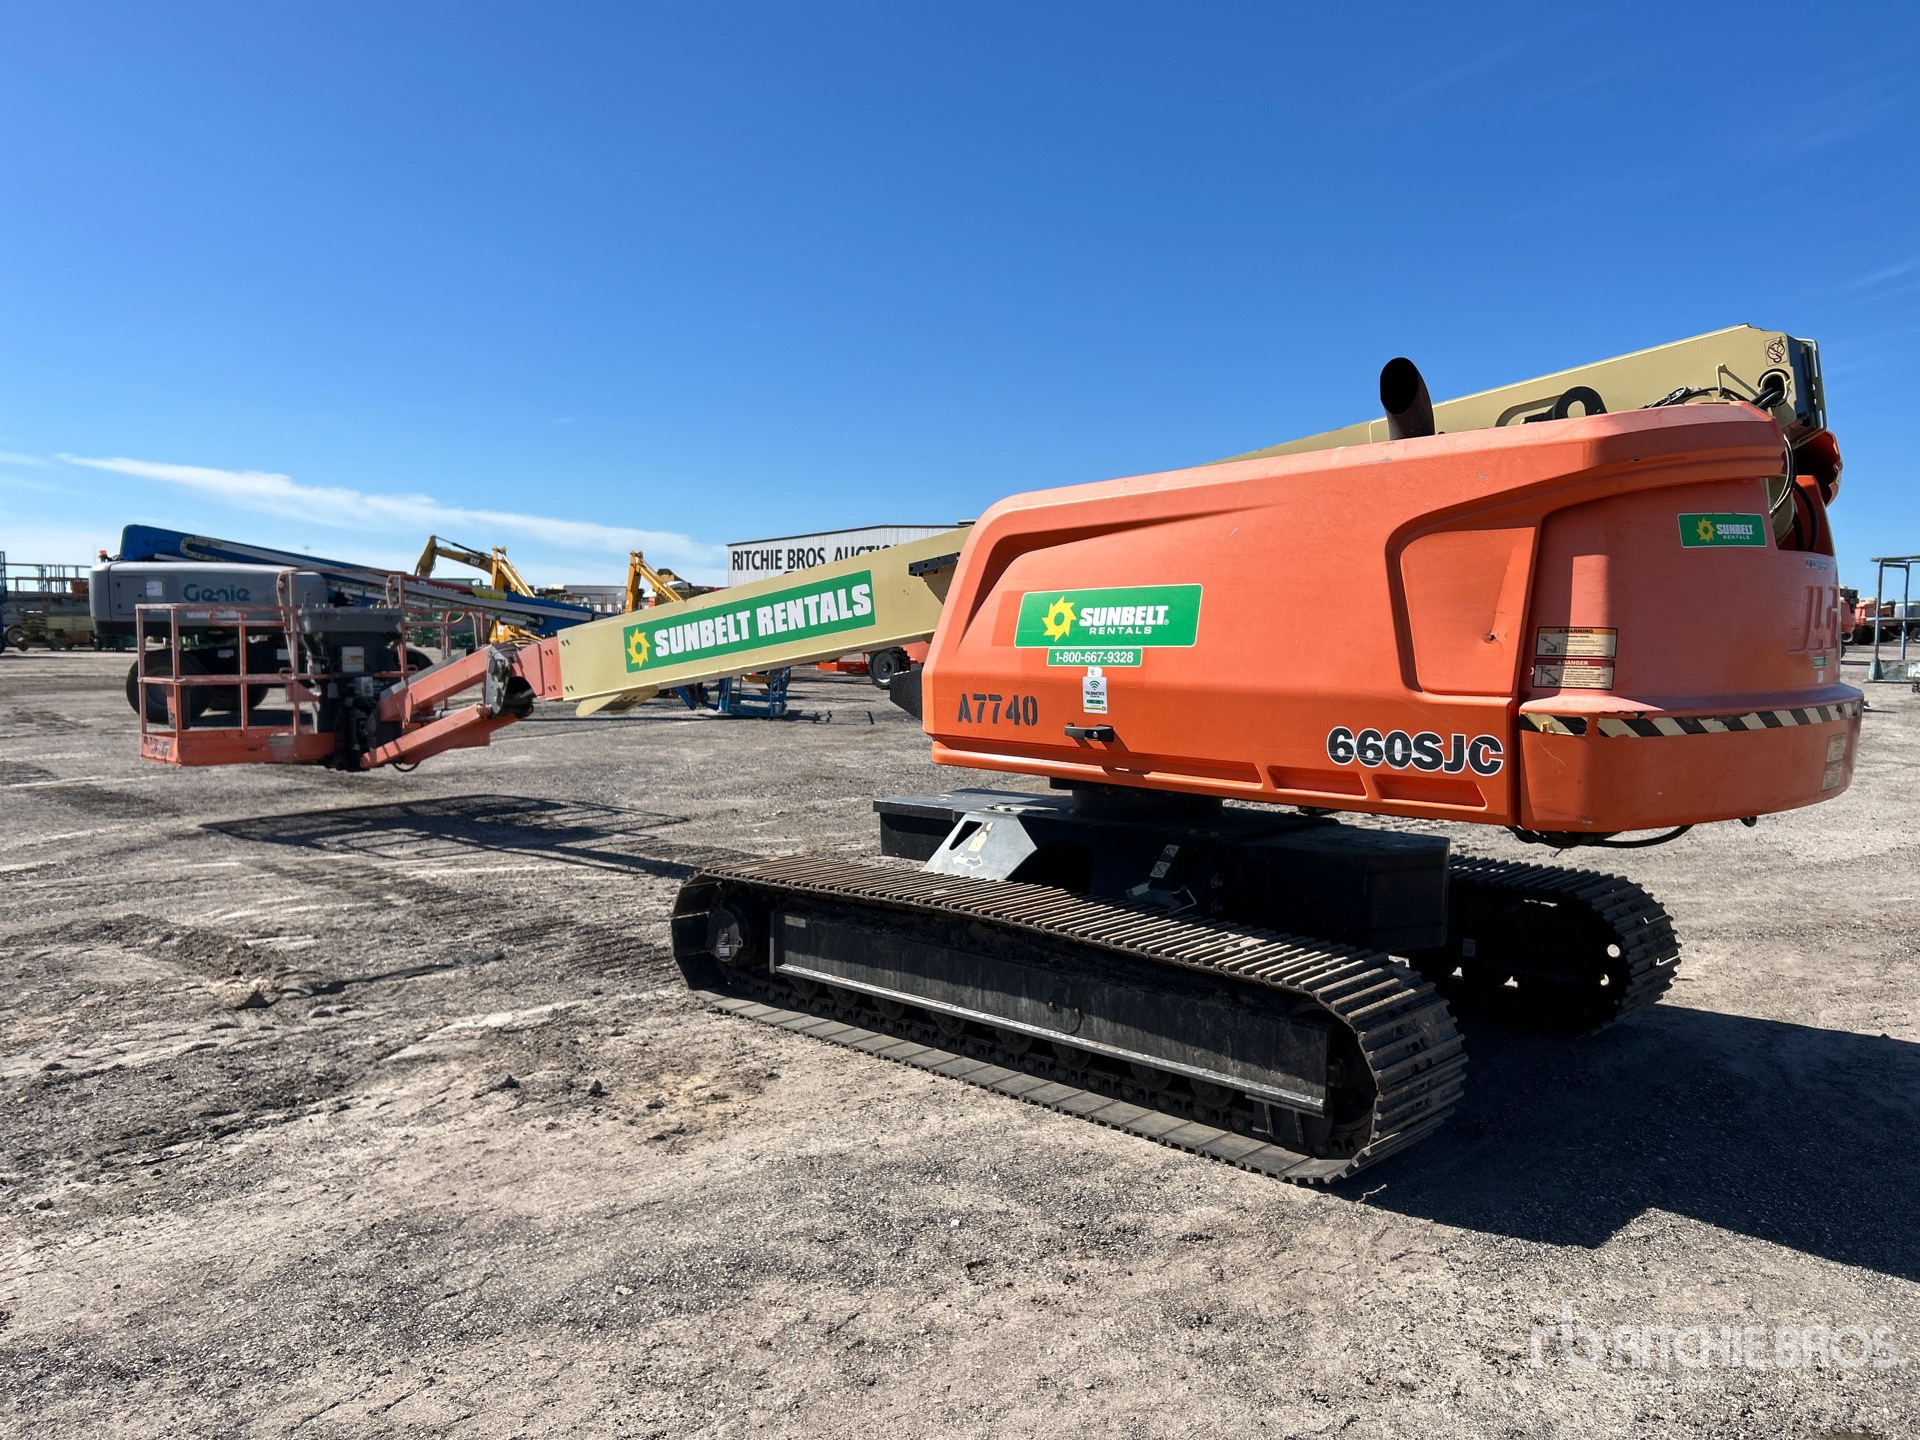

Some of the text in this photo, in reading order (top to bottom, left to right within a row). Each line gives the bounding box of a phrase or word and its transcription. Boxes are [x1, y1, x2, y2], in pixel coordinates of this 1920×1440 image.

[1716, 524, 1753, 535] SUNBELT
[732, 549, 783, 571] RITCHIE
[183, 583, 250, 602] Genie
[654, 583, 872, 657] SUNBELT RENTALS
[1079, 605, 1169, 626] SUNBELT
[1089, 626, 1152, 635] RENTALS
[1055, 651, 1134, 663] 1-800-667-9328
[958, 693, 1038, 726] A7740
[1327, 725, 1504, 776] 660SJC
